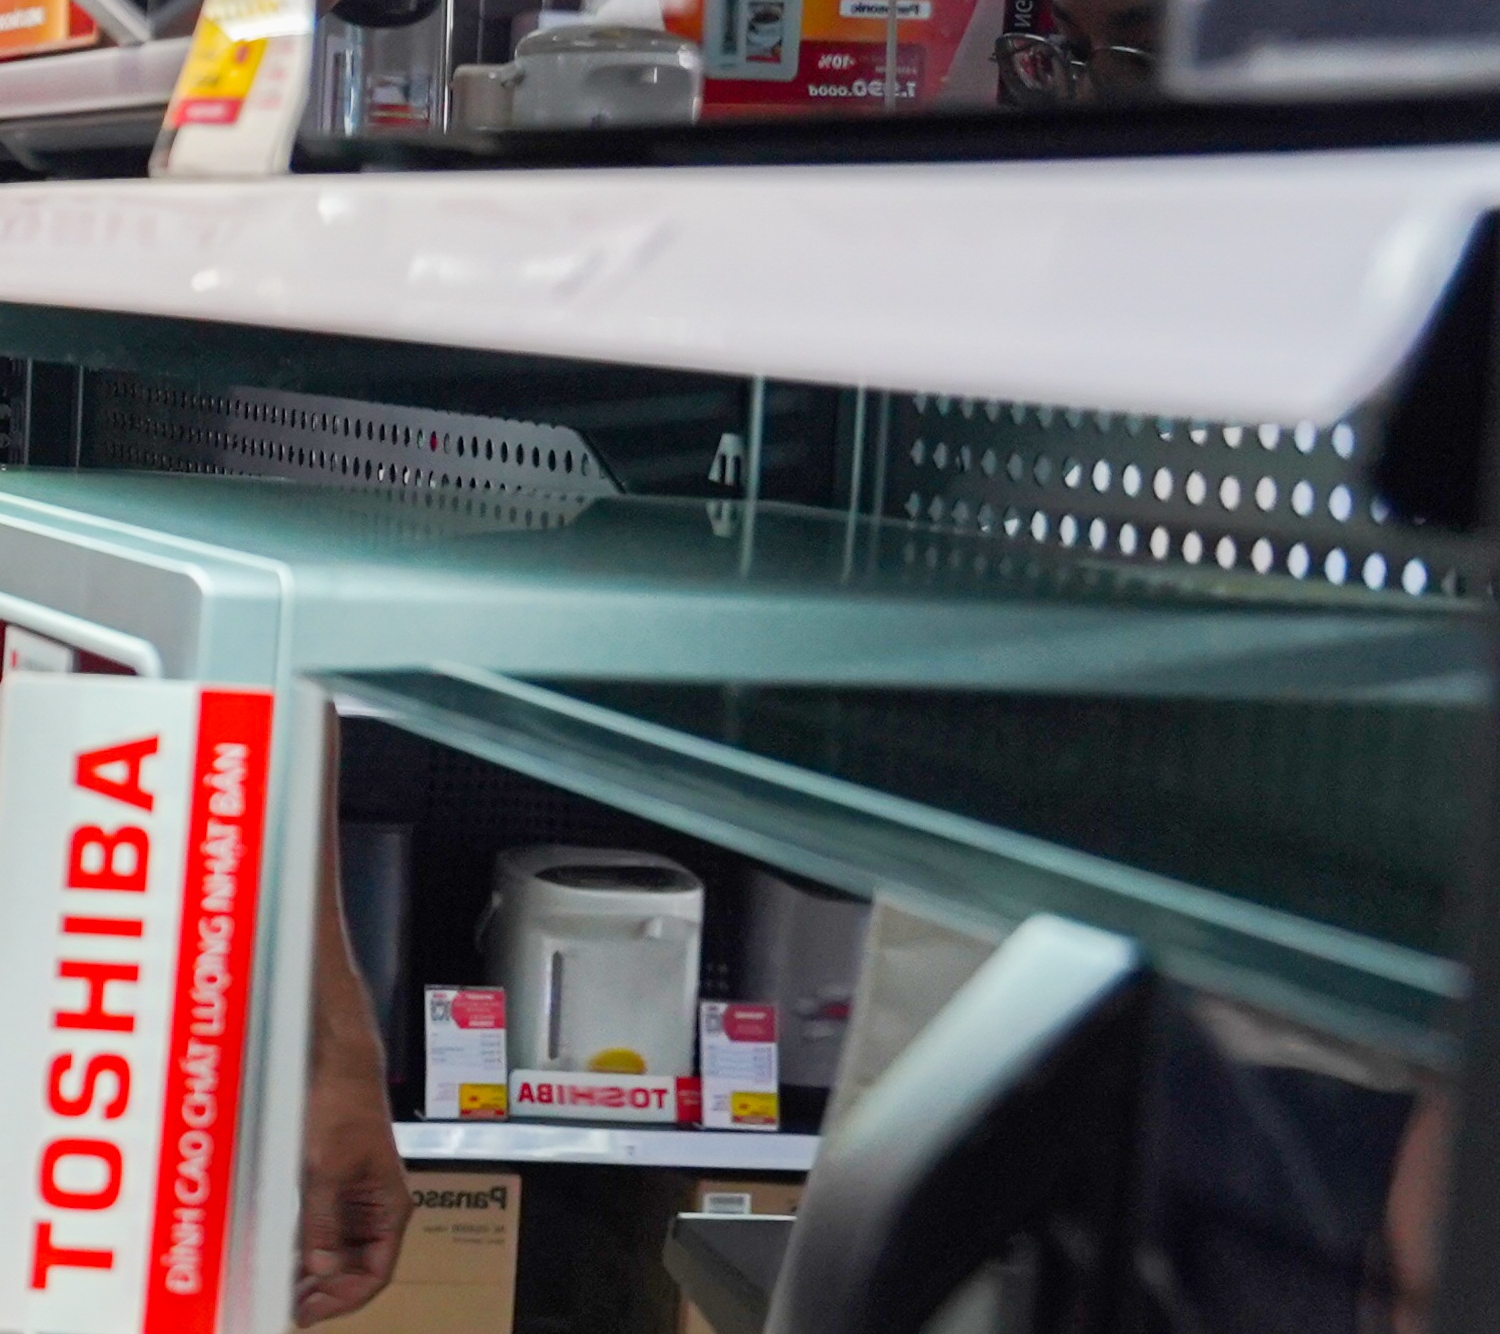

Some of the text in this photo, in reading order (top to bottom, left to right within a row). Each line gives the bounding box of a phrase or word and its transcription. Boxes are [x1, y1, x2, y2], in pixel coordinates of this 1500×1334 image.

[207, 743, 249, 816] BẢN
[200, 821, 247, 912] NHẬT
[28, 734, 162, 1292] TOSHIBA
[190, 915, 234, 1036] LƯỢNG
[180, 1041, 220, 1126] CHẤT
[174, 1131, 214, 1204] CAO
